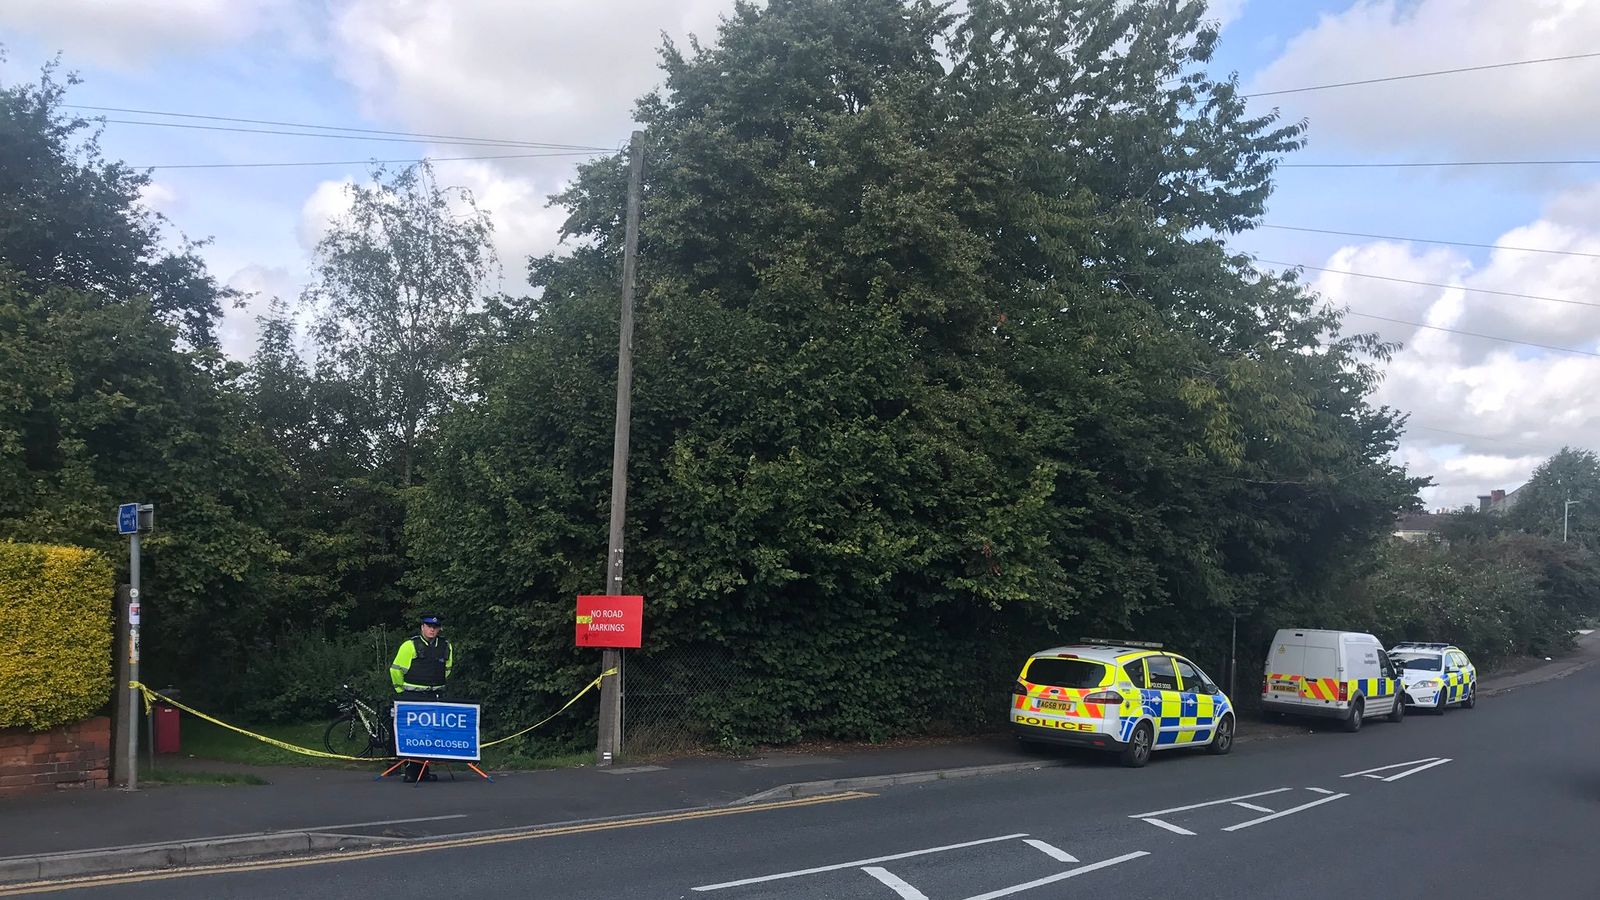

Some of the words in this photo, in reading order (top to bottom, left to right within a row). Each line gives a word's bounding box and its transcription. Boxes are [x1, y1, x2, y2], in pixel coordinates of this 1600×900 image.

[591, 609, 601, 618] NO
[602, 609, 624, 618] ROAD
[588, 623, 625, 632] MARKINGS
[406, 711, 467, 729] POLICE
[1016, 715, 1093, 732] POLICE
[405, 738, 432, 747] ROAD
[434, 739, 470, 749] CLOSED
